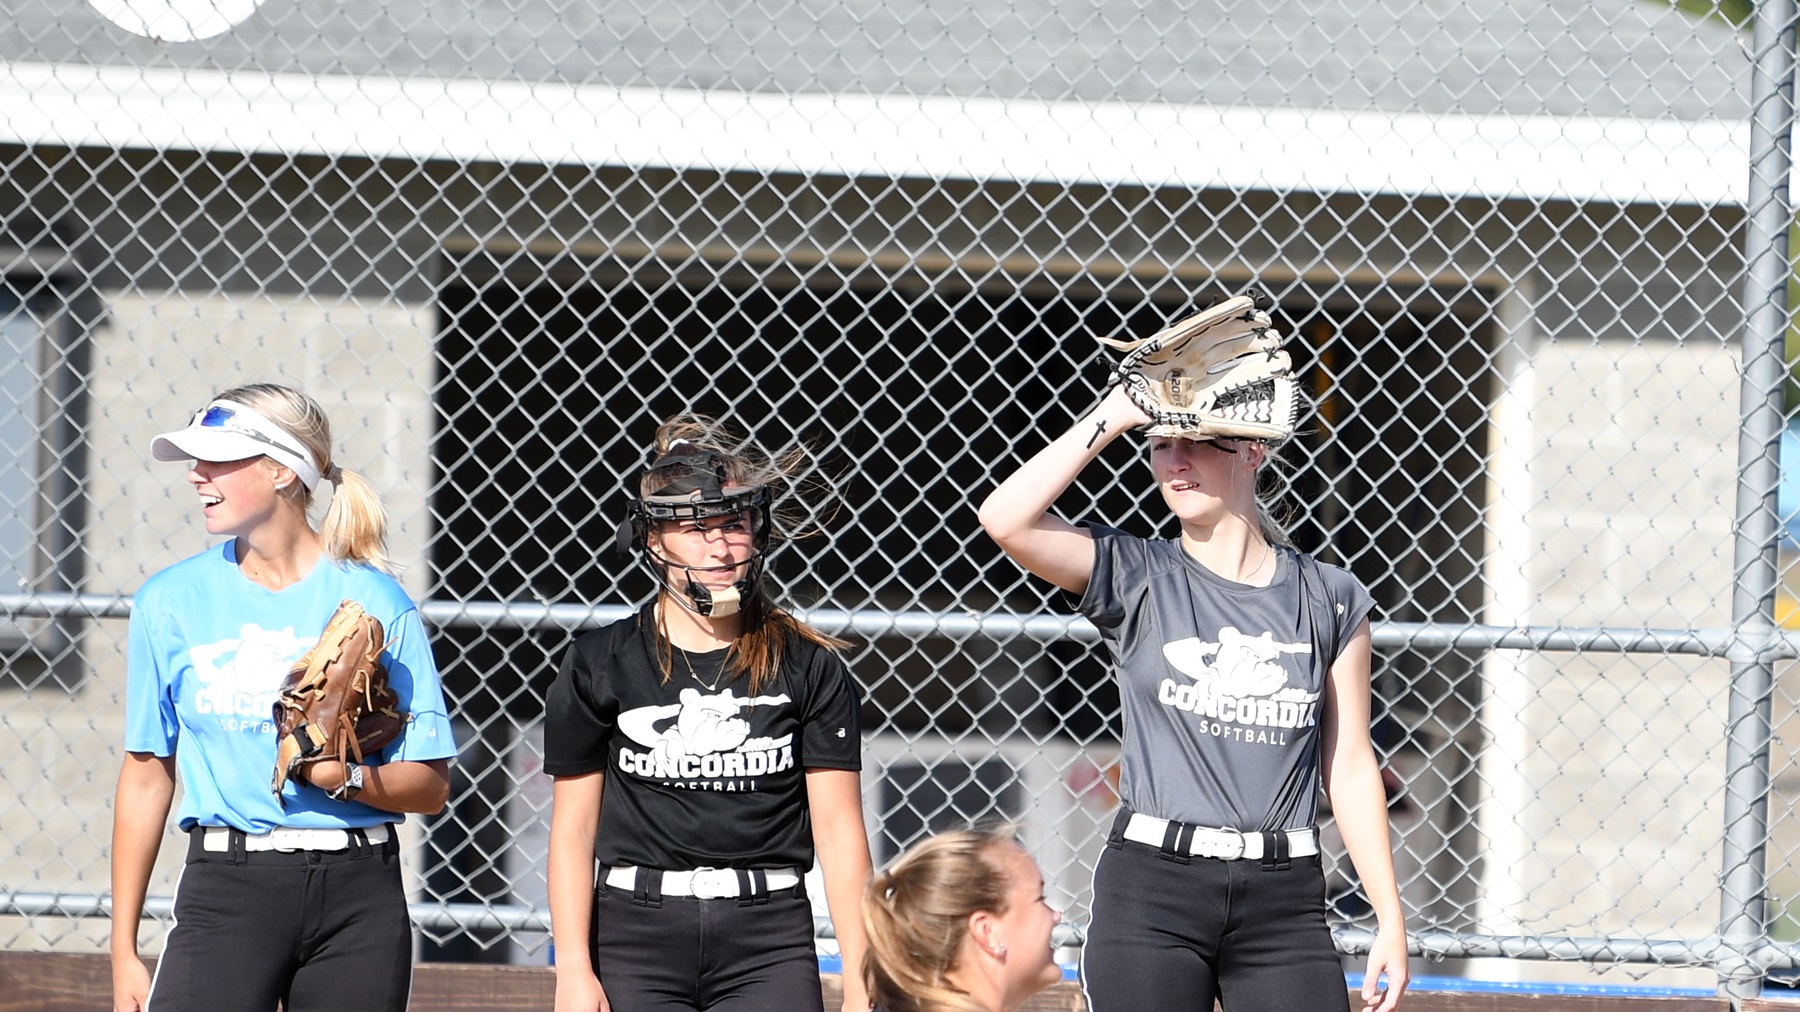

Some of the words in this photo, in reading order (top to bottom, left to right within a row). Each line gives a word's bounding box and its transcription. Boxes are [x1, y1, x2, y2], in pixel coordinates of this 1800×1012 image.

[1158, 677, 1317, 729] CONCORDIA
[220, 718, 276, 733] SOFTB
[1199, 720, 1286, 746] SOFTBALL
[618, 745, 794, 779] CONCORDIA
